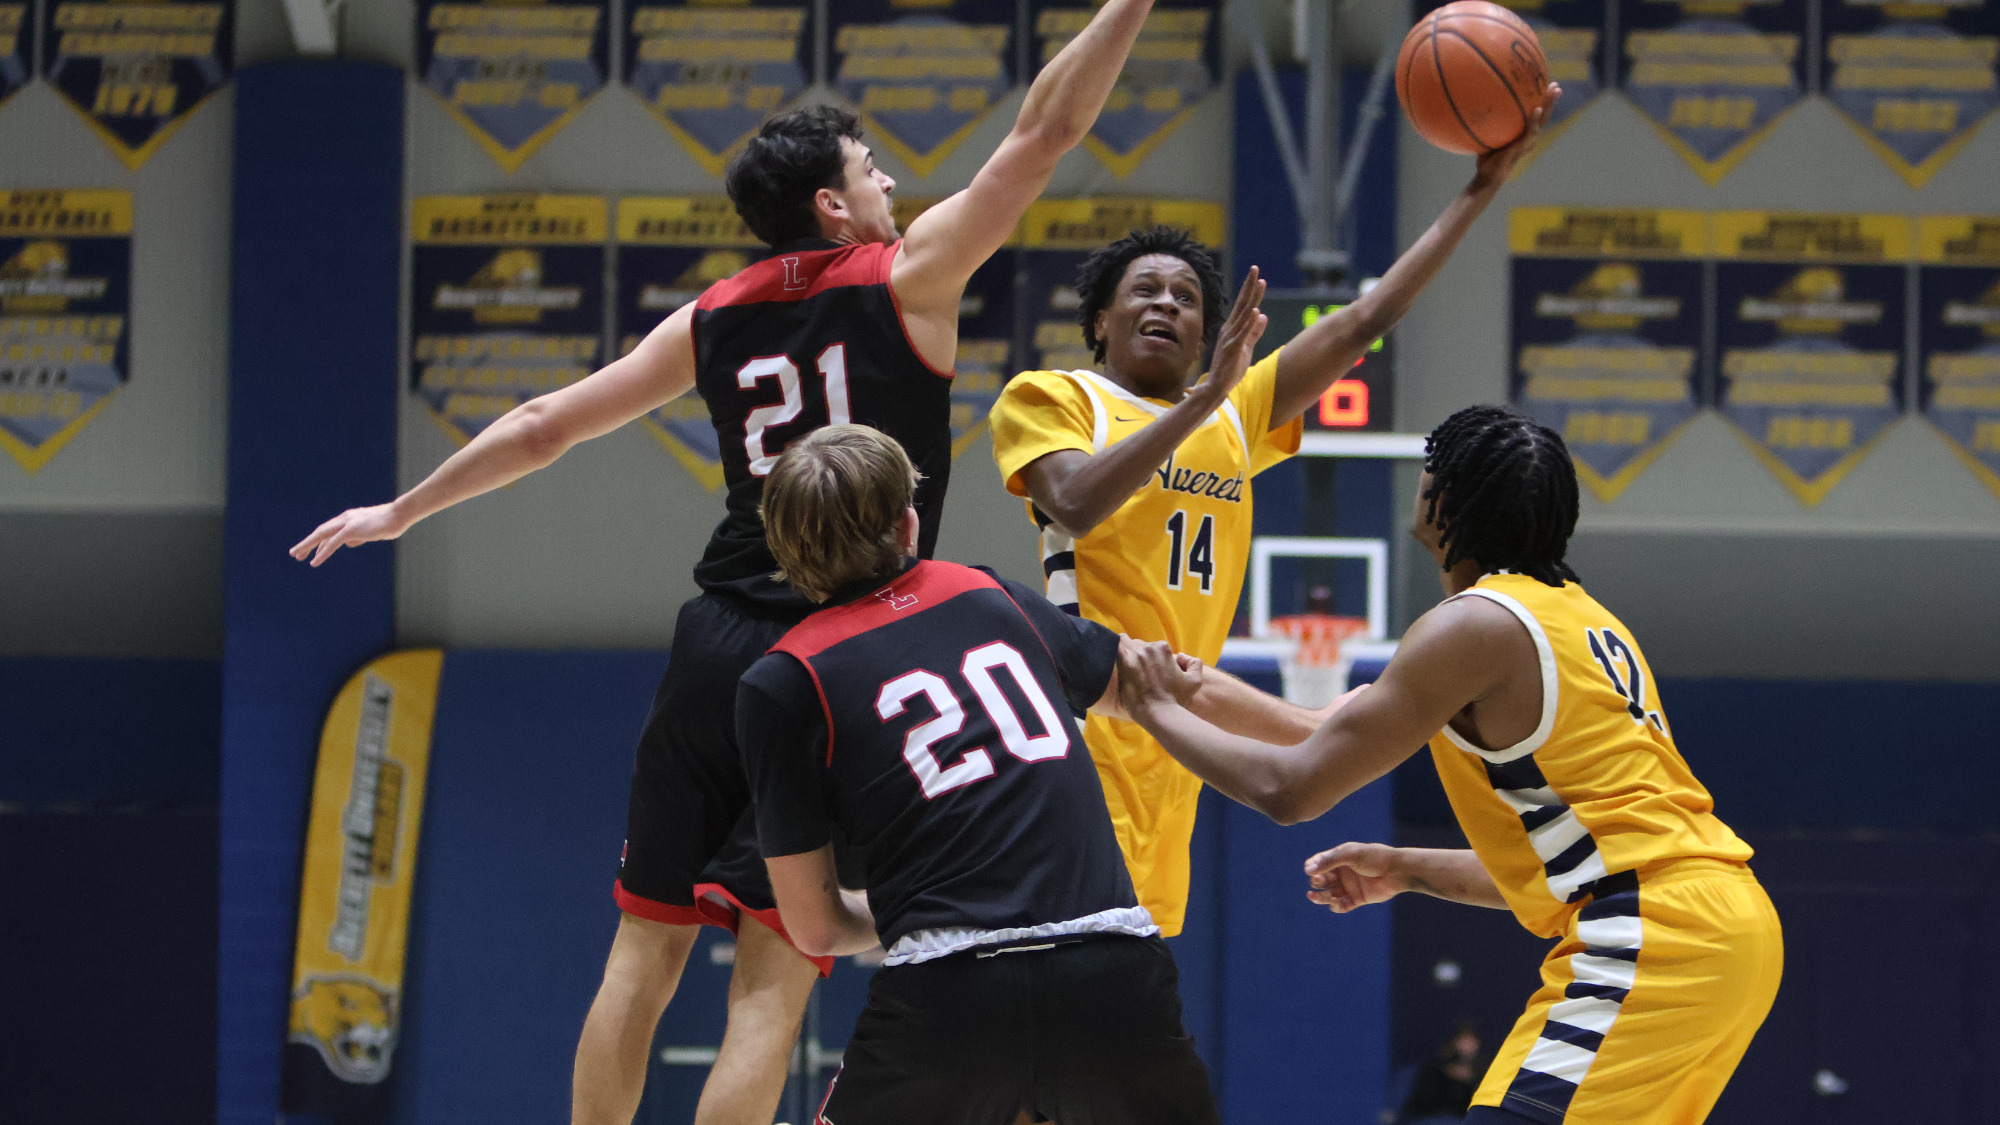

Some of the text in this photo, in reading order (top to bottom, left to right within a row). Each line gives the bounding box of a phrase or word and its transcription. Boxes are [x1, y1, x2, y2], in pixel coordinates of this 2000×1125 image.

[781, 257, 807, 291] L
[735, 341, 852, 477] 21
[1141, 450, 1243, 503] Averet
[1166, 508, 1216, 596] 14
[873, 638, 1072, 801] 20
[1584, 627, 1669, 738] 12
